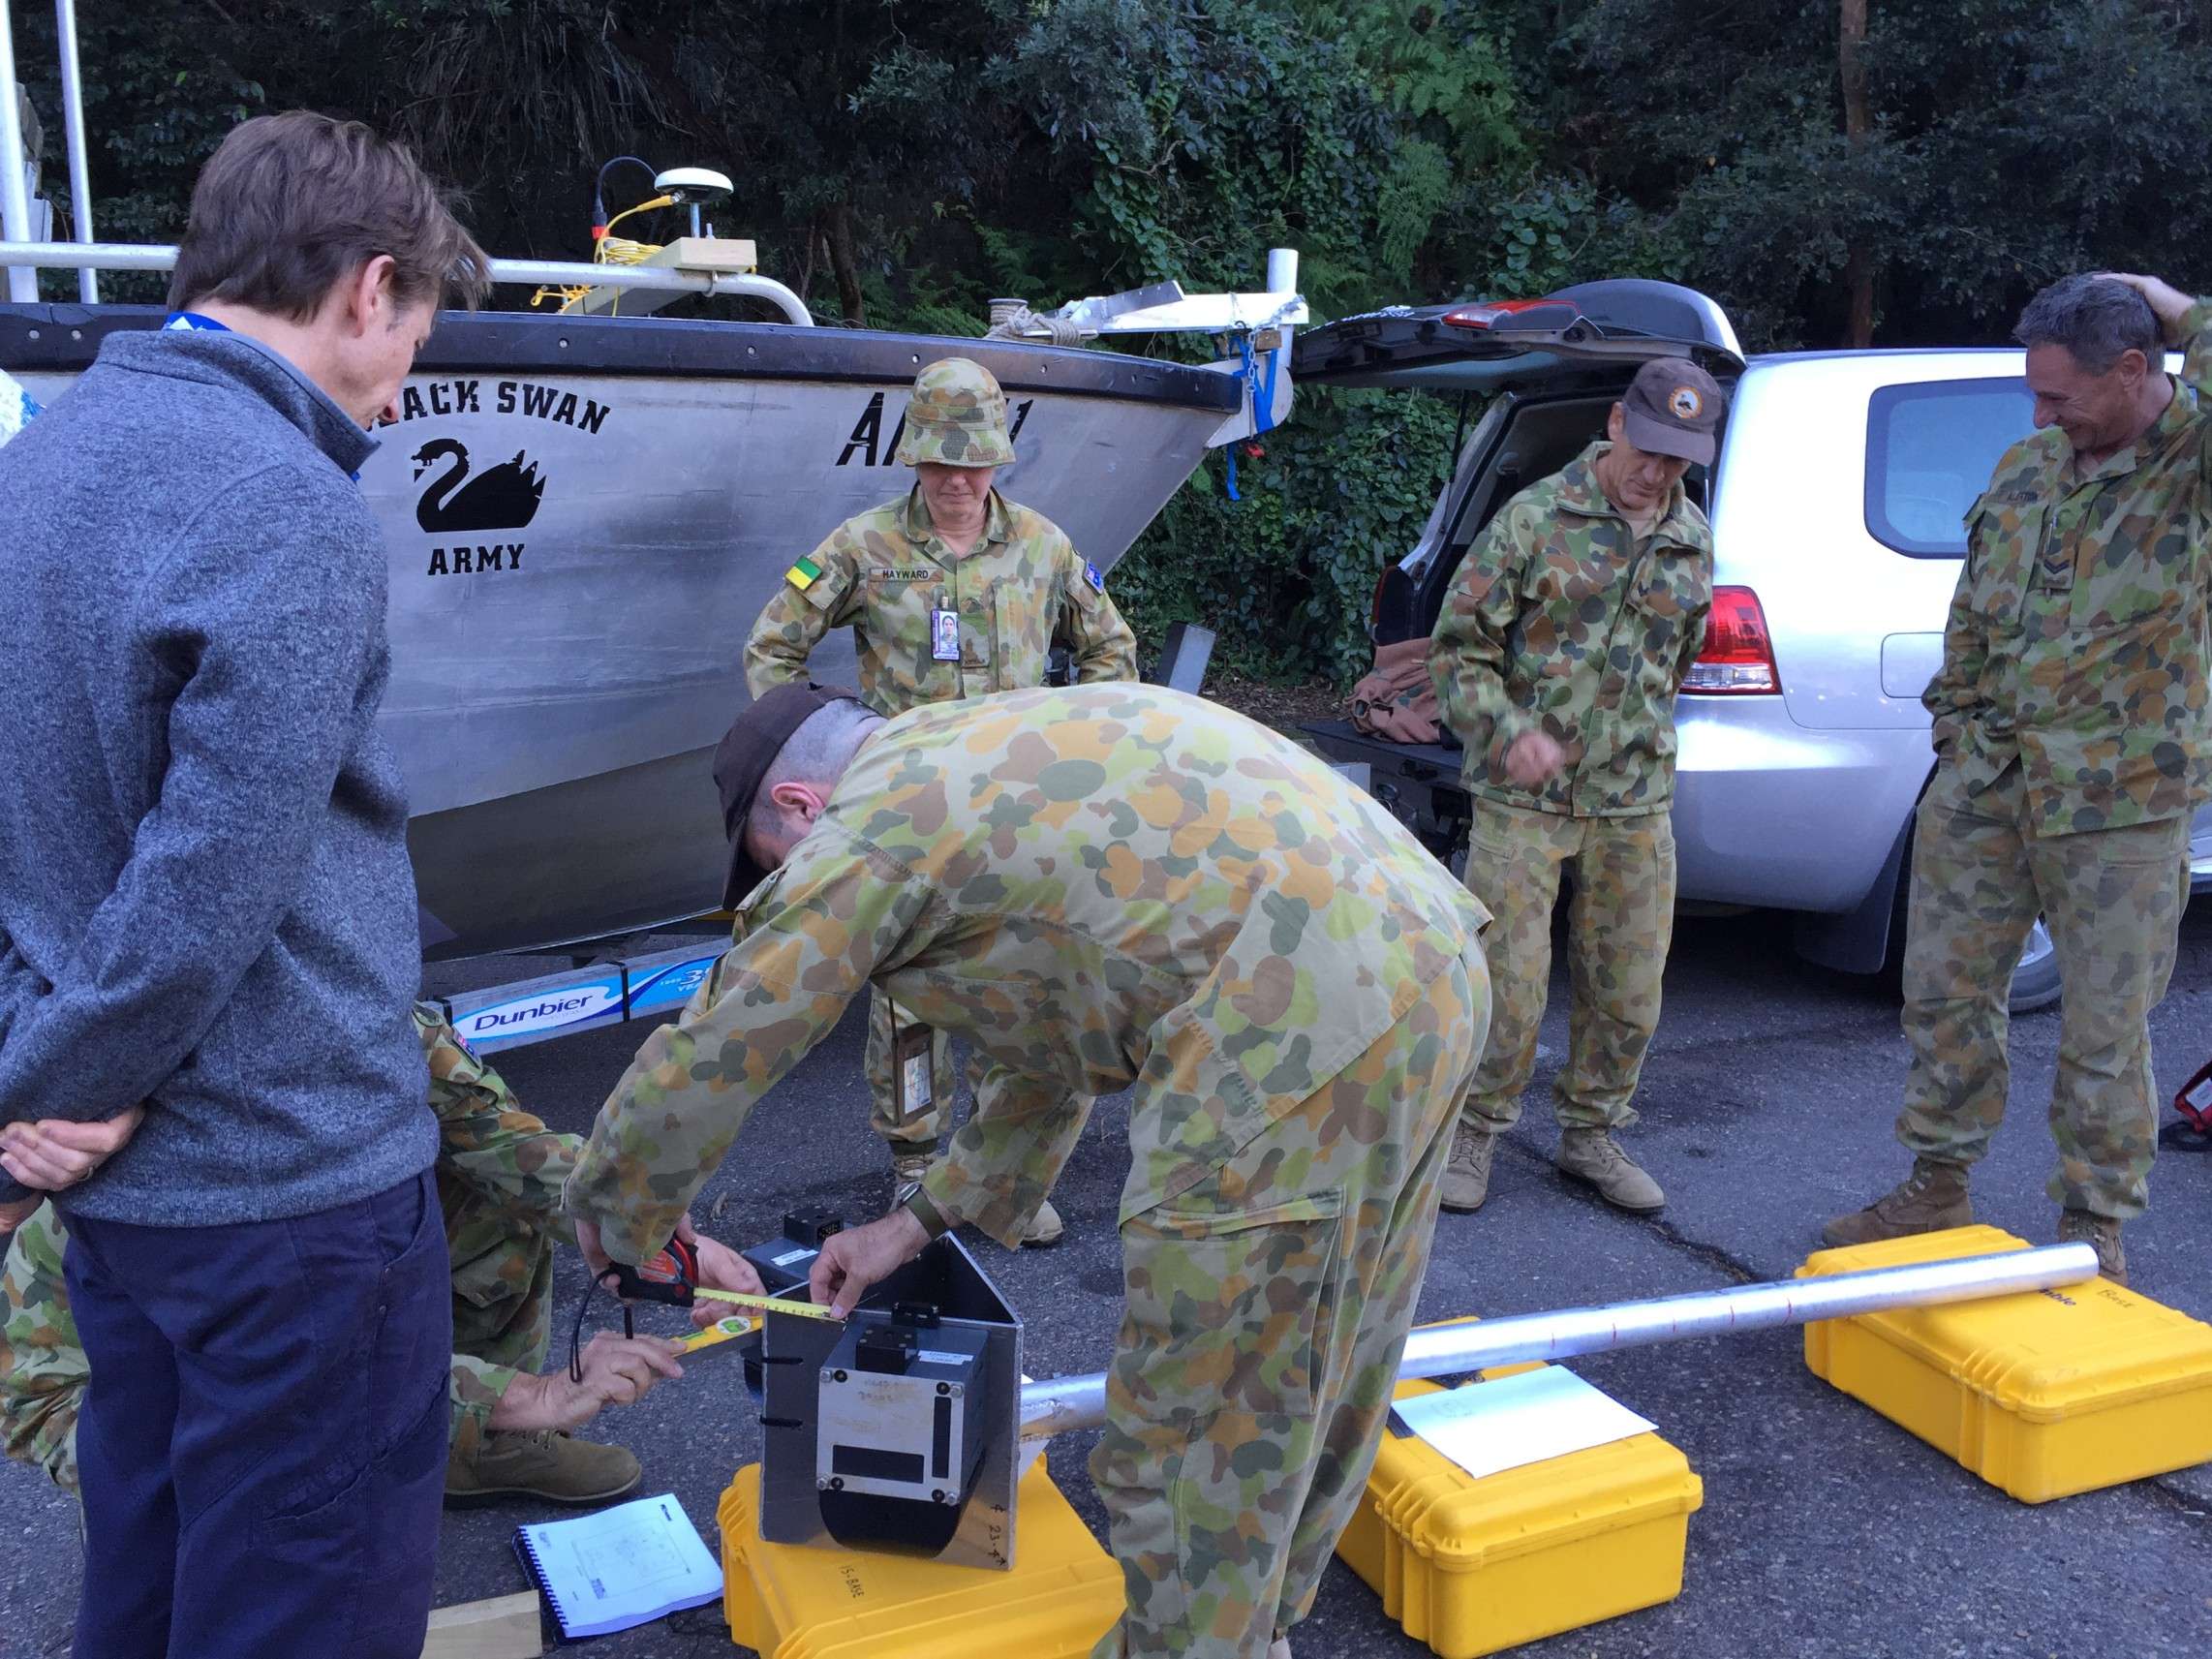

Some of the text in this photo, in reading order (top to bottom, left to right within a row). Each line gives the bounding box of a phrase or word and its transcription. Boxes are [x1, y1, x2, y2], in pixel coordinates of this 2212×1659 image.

[379, 380, 610, 434] ACK SWAN
[427, 543, 526, 576] ARMY
[882, 569, 929, 580] HAYWARD
[475, 995, 593, 1031] Dunbier
